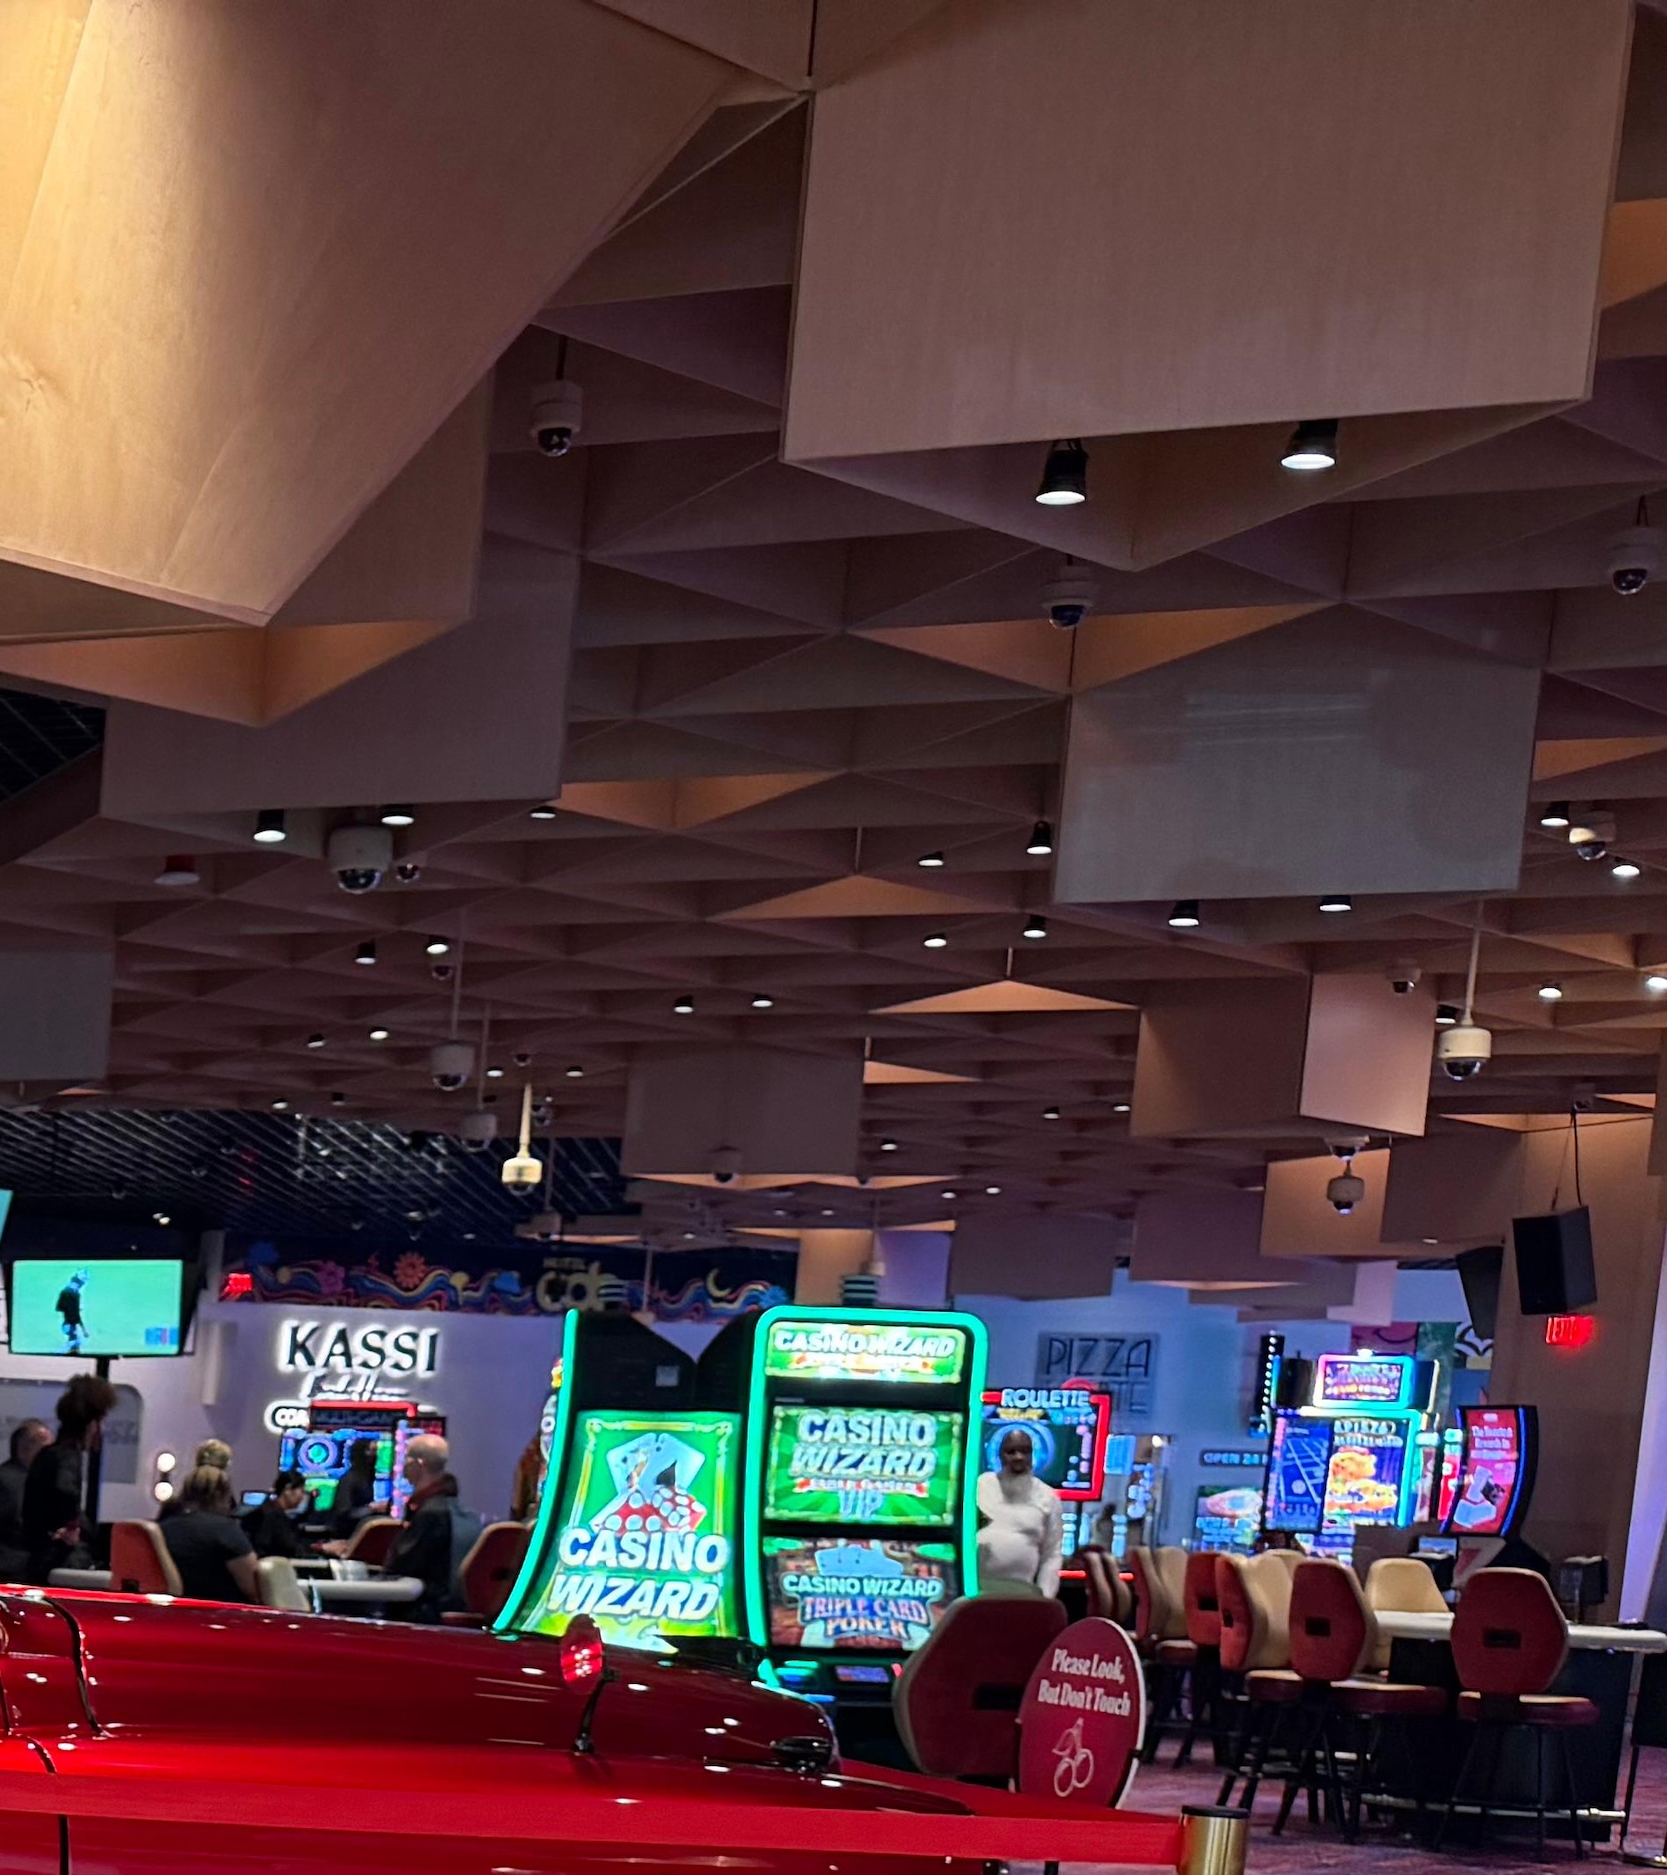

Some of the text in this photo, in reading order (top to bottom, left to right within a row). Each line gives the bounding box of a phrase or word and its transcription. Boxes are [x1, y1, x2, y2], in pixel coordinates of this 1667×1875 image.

[285, 1323, 441, 1373] KASSI
[774, 1329, 866, 1354] CASINO
[1046, 1337, 1152, 1377] PIZZA
[1000, 1388, 1090, 1408] ROULETTE
[798, 1411, 937, 1447] CASINO
[789, 1446, 938, 1480] WIZARD
[838, 1489, 885, 1521] VIP
[558, 1527, 730, 1573] CASINO
[546, 1573, 720, 1621] WIZARD
[782, 1574, 944, 1599] CASINO WIZARD
[803, 1597, 929, 1627] TRIPLE CARD
[827, 1617, 909, 1641] POKER
[1051, 1648, 1126, 1685] Please Look,
[1037, 1679, 1131, 1717] But Don't Touch
